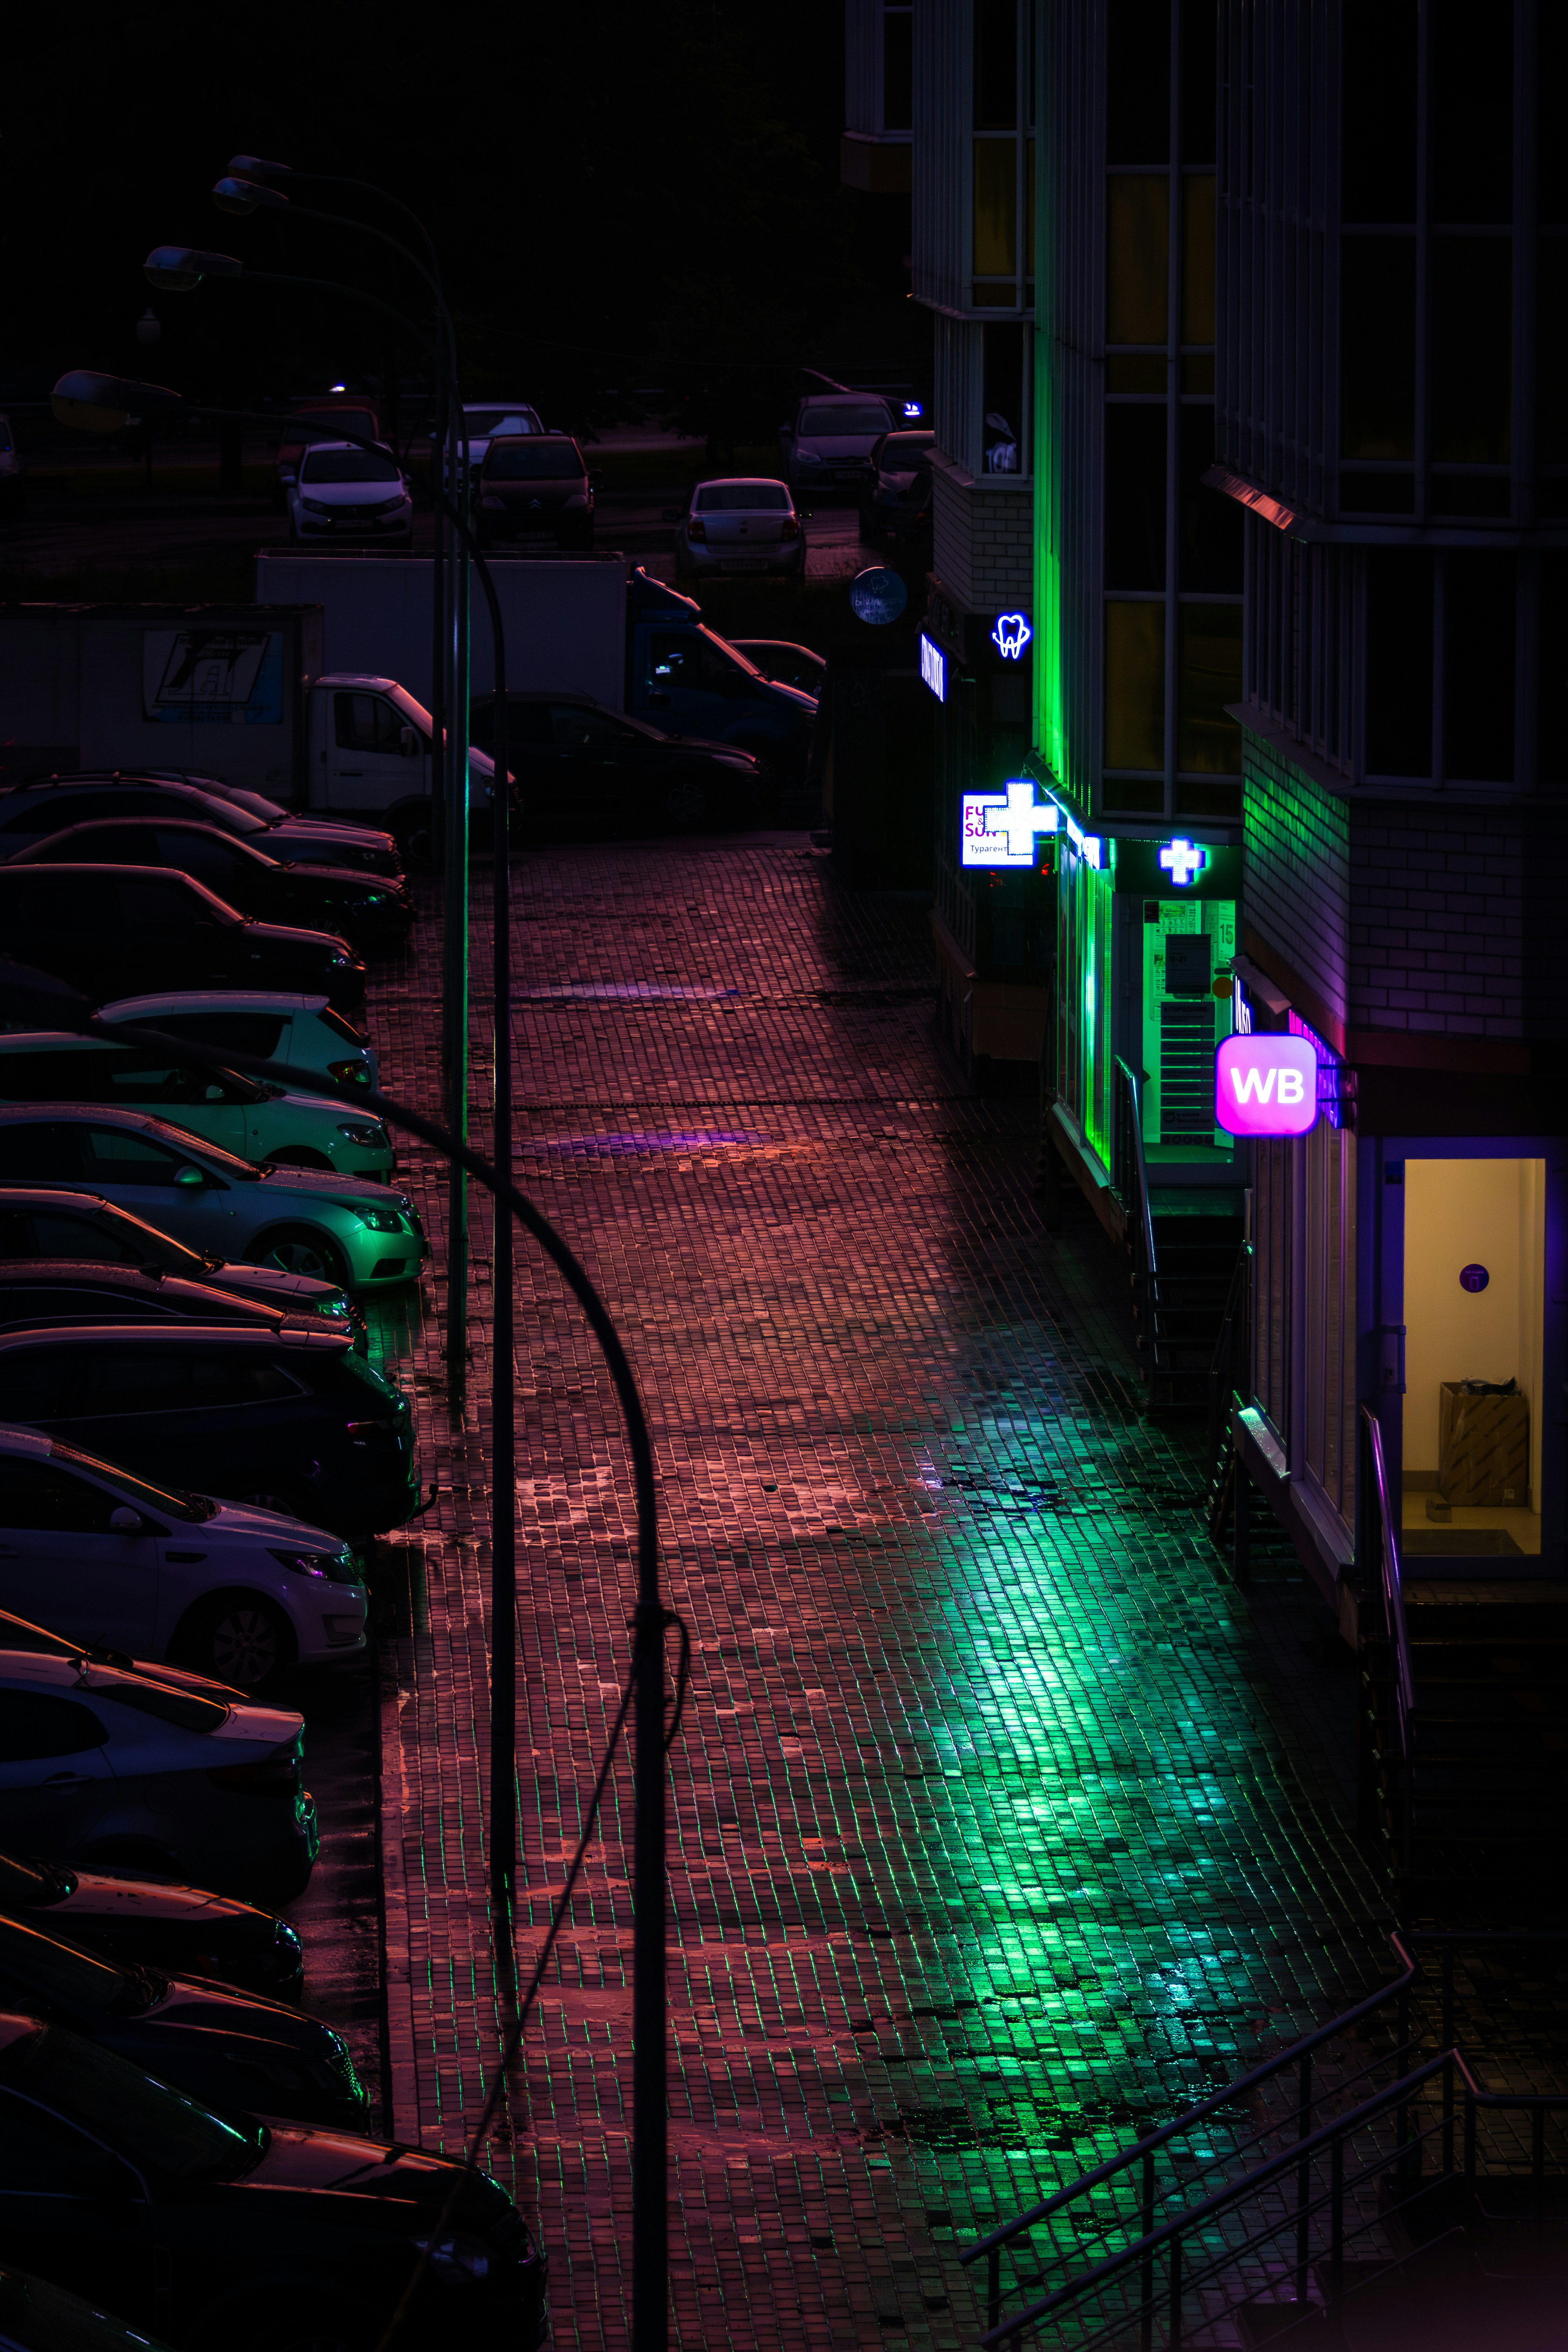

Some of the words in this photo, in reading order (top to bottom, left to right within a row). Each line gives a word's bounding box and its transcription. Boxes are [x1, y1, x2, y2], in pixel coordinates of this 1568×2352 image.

[966, 806, 984, 820] FU
[970, 845, 1008, 854] Турагент
[1220, 923, 1234, 945] 15
[1230, 1067, 1305, 1104] WB
